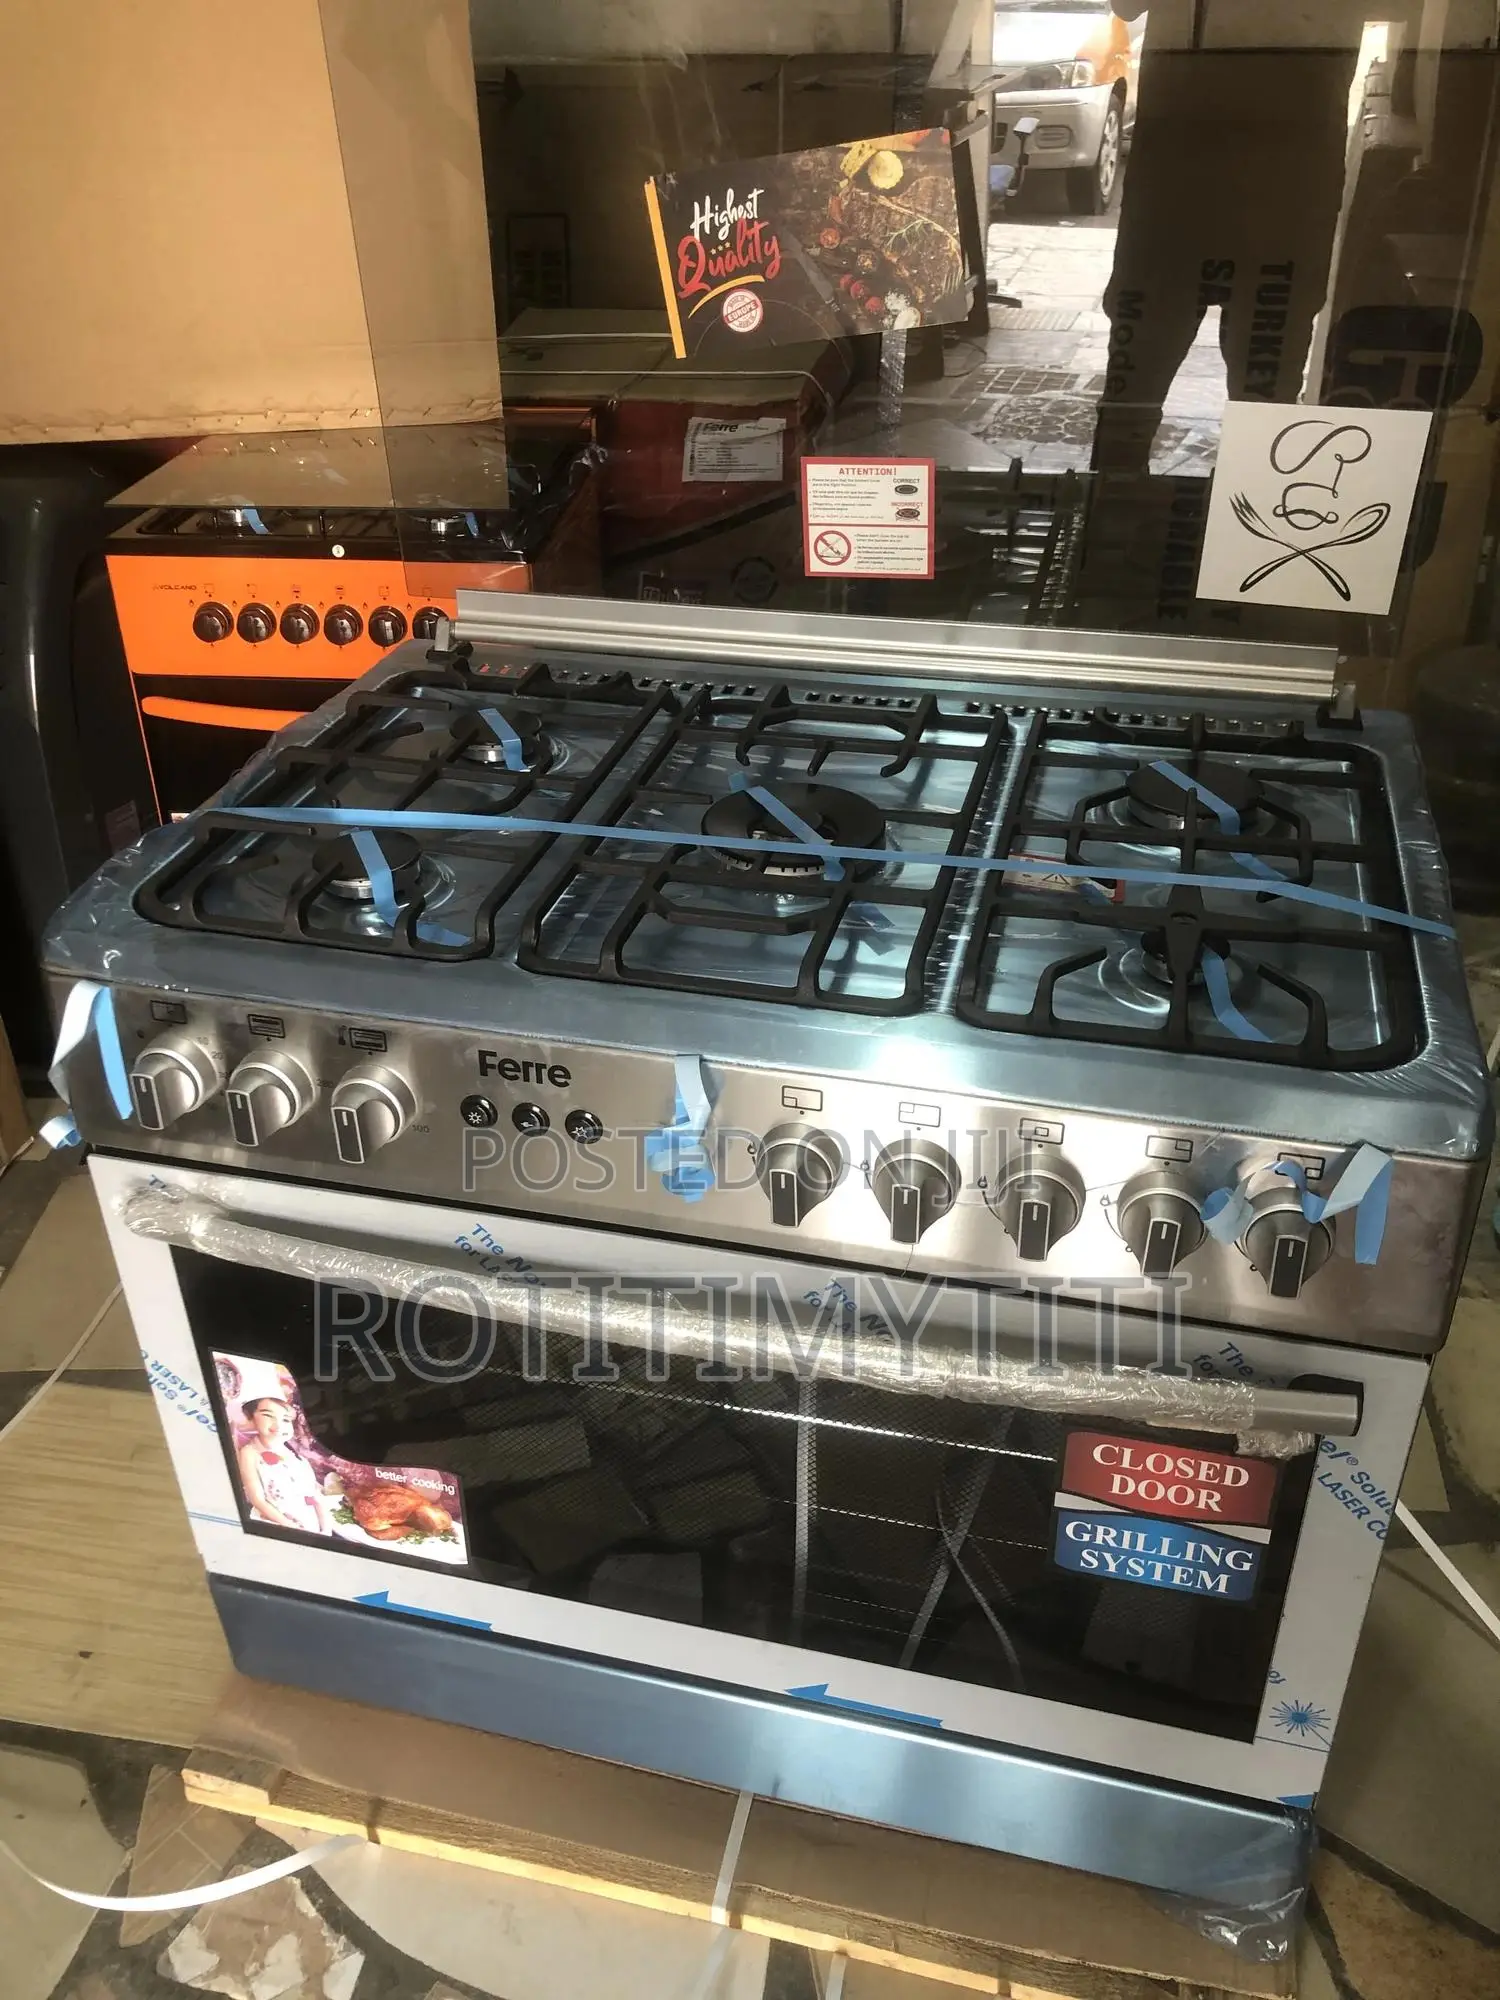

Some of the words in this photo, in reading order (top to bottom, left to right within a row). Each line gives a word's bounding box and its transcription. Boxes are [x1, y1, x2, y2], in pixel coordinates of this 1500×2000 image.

[690, 187, 764, 243] Highest
[678, 217, 781, 299] Quality
[1243, 260, 1295, 399] TURKEY
[839, 467, 897, 476] ATTENTION!
[478, 1050, 572, 1088] Ferre
[454, 1235, 480, 1257] for
[472, 1223, 504, 1255] The
[1219, 1342, 1254, 1377] The
[375, 1467, 408, 1484] better
[411, 1477, 455, 1496] cooking
[1093, 1443, 1250, 1488] CLOSED
[1109, 1473, 1223, 1513] DOOR
[1317, 1472, 1370, 1520] LASER
[1065, 1520, 1254, 1571] GRILLING
[1080, 1548, 1232, 1594] SYSTEM
